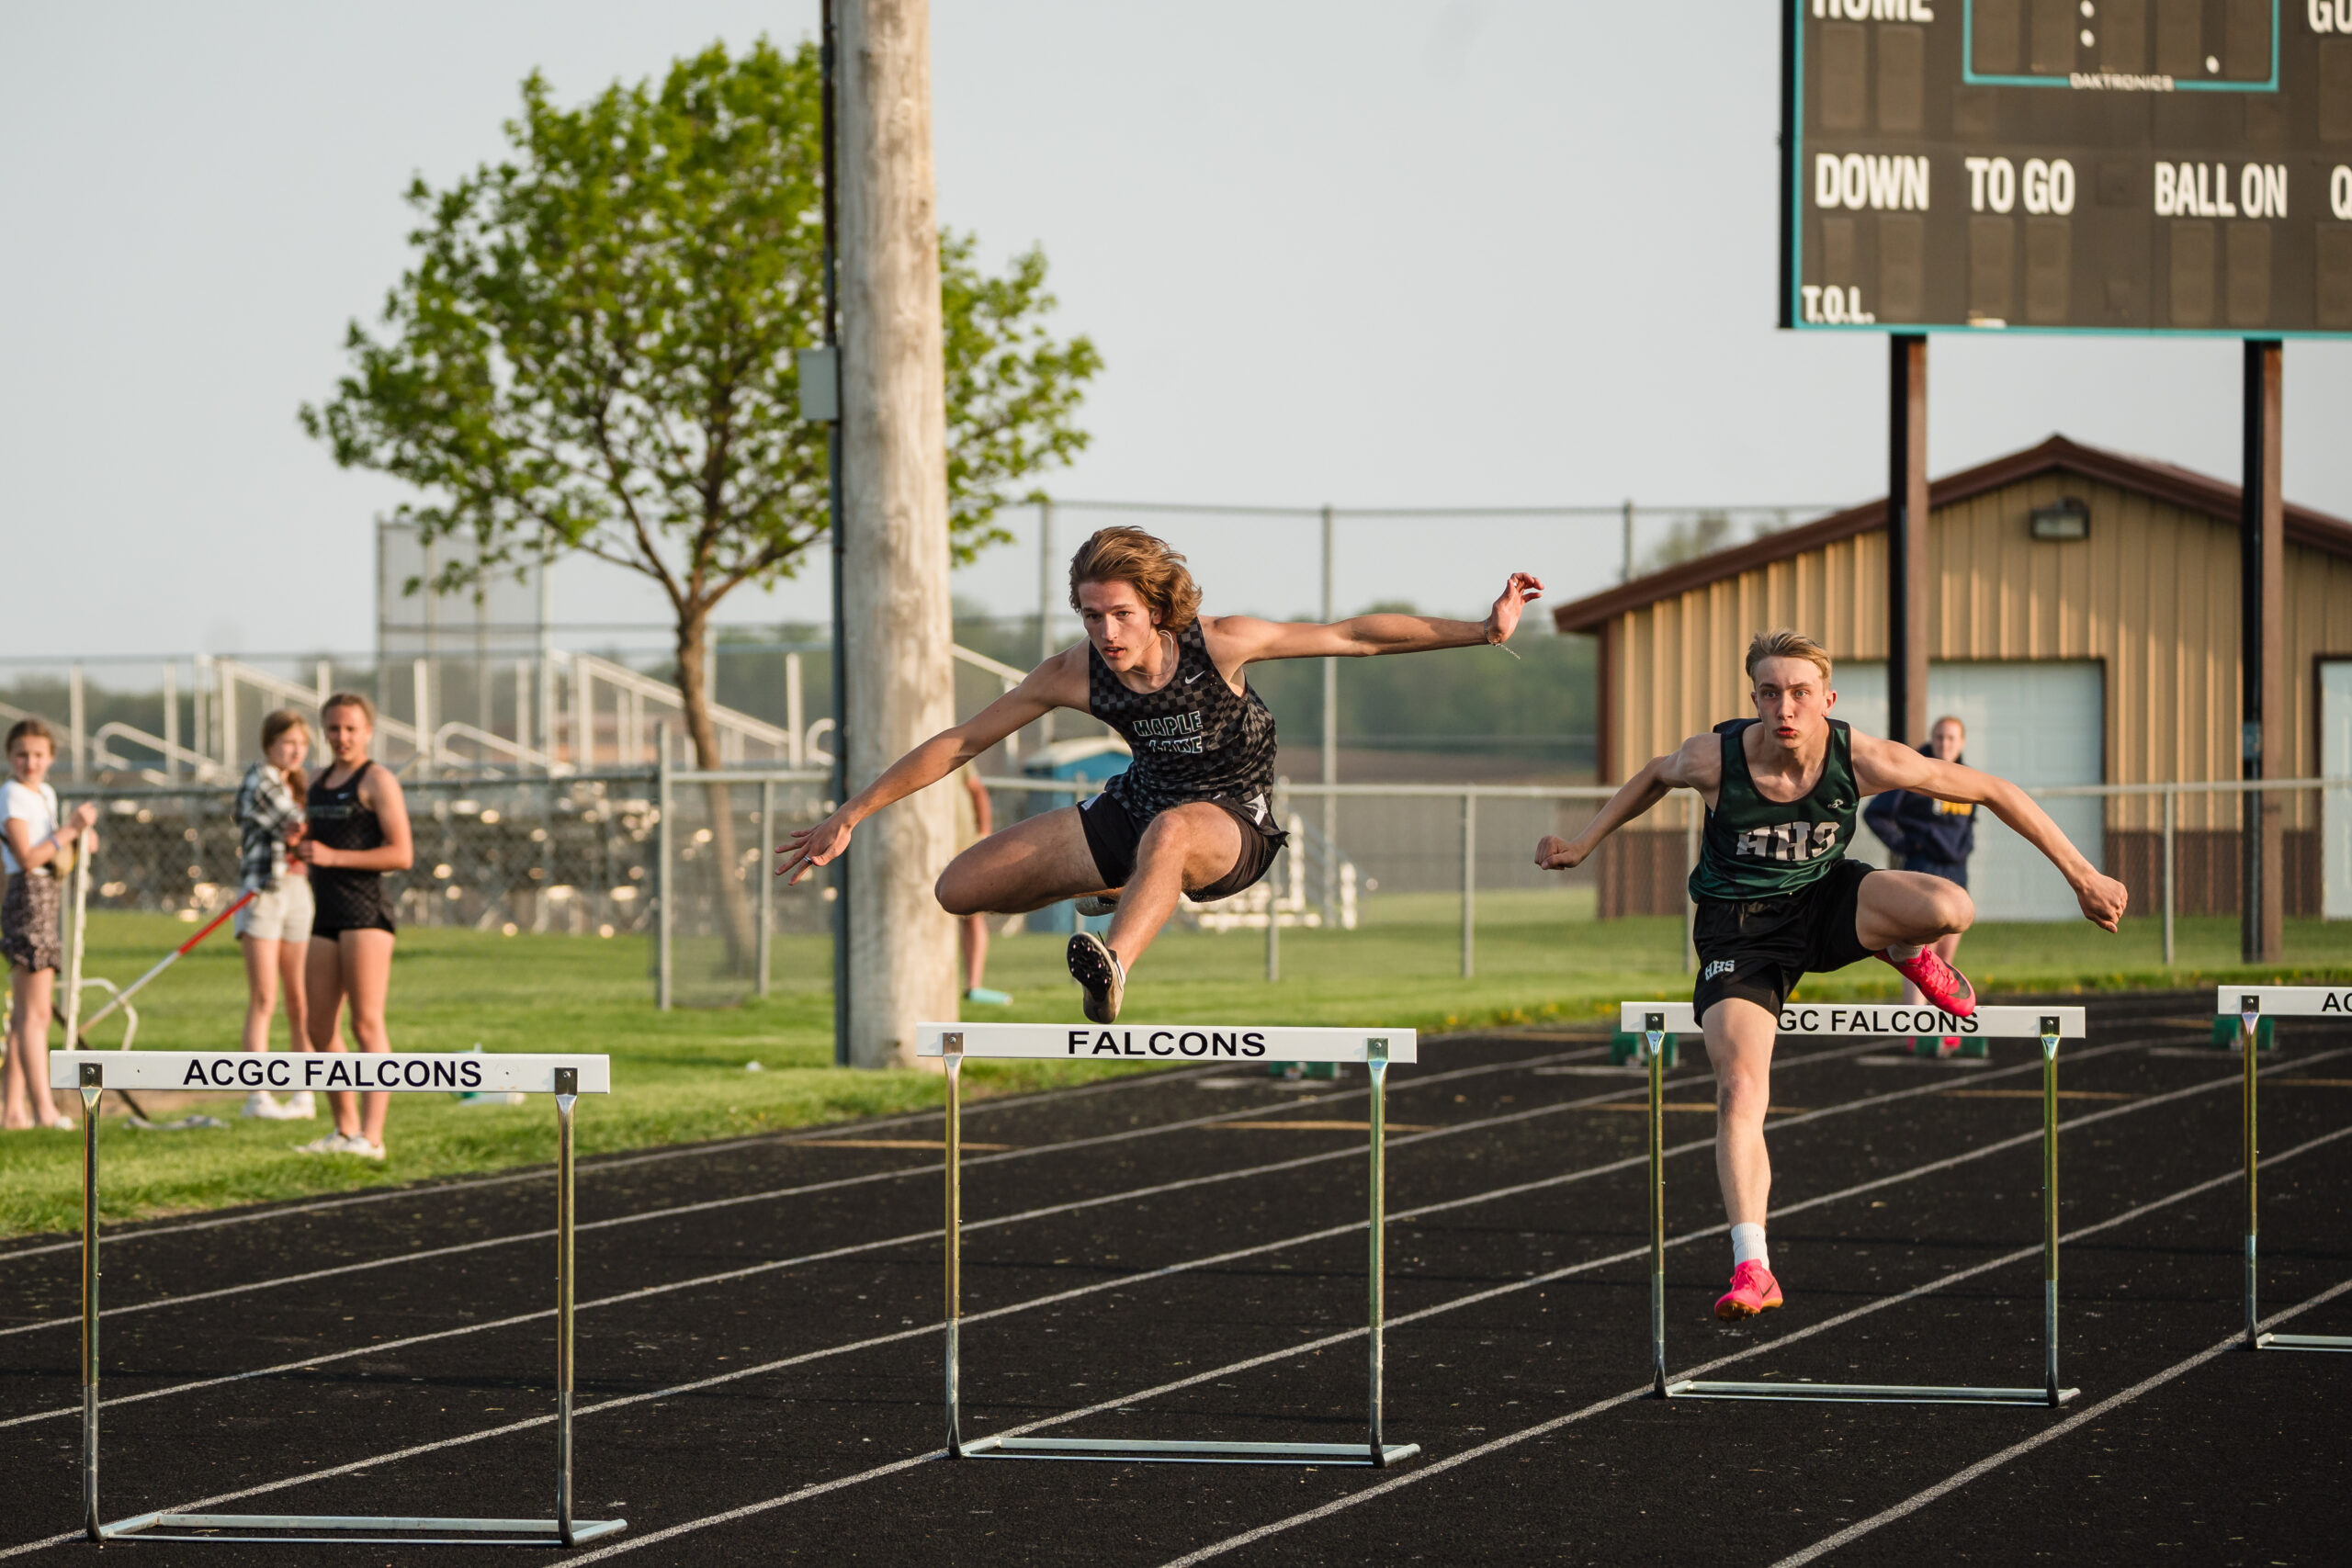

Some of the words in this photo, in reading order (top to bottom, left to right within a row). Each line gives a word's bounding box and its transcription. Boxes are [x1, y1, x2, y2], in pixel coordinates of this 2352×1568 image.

[1815, 153, 1929, 210] DOWN
[1965, 157, 2015, 214] TO
[2023, 158, 2075, 215] GO
[2154, 161, 2236, 217] BALL
[2241, 163, 2288, 218] ON
[1802, 285, 1875, 324] T.O.L.
[1133, 710, 1204, 736] MAPLE
[1704, 960, 1735, 981] HHS
[1831, 1010, 1979, 1033] FALCONS
[1068, 1030, 1266, 1057] FALCONS
[182, 1058, 290, 1087] ACGC
[304, 1059, 482, 1088] FALCONS
